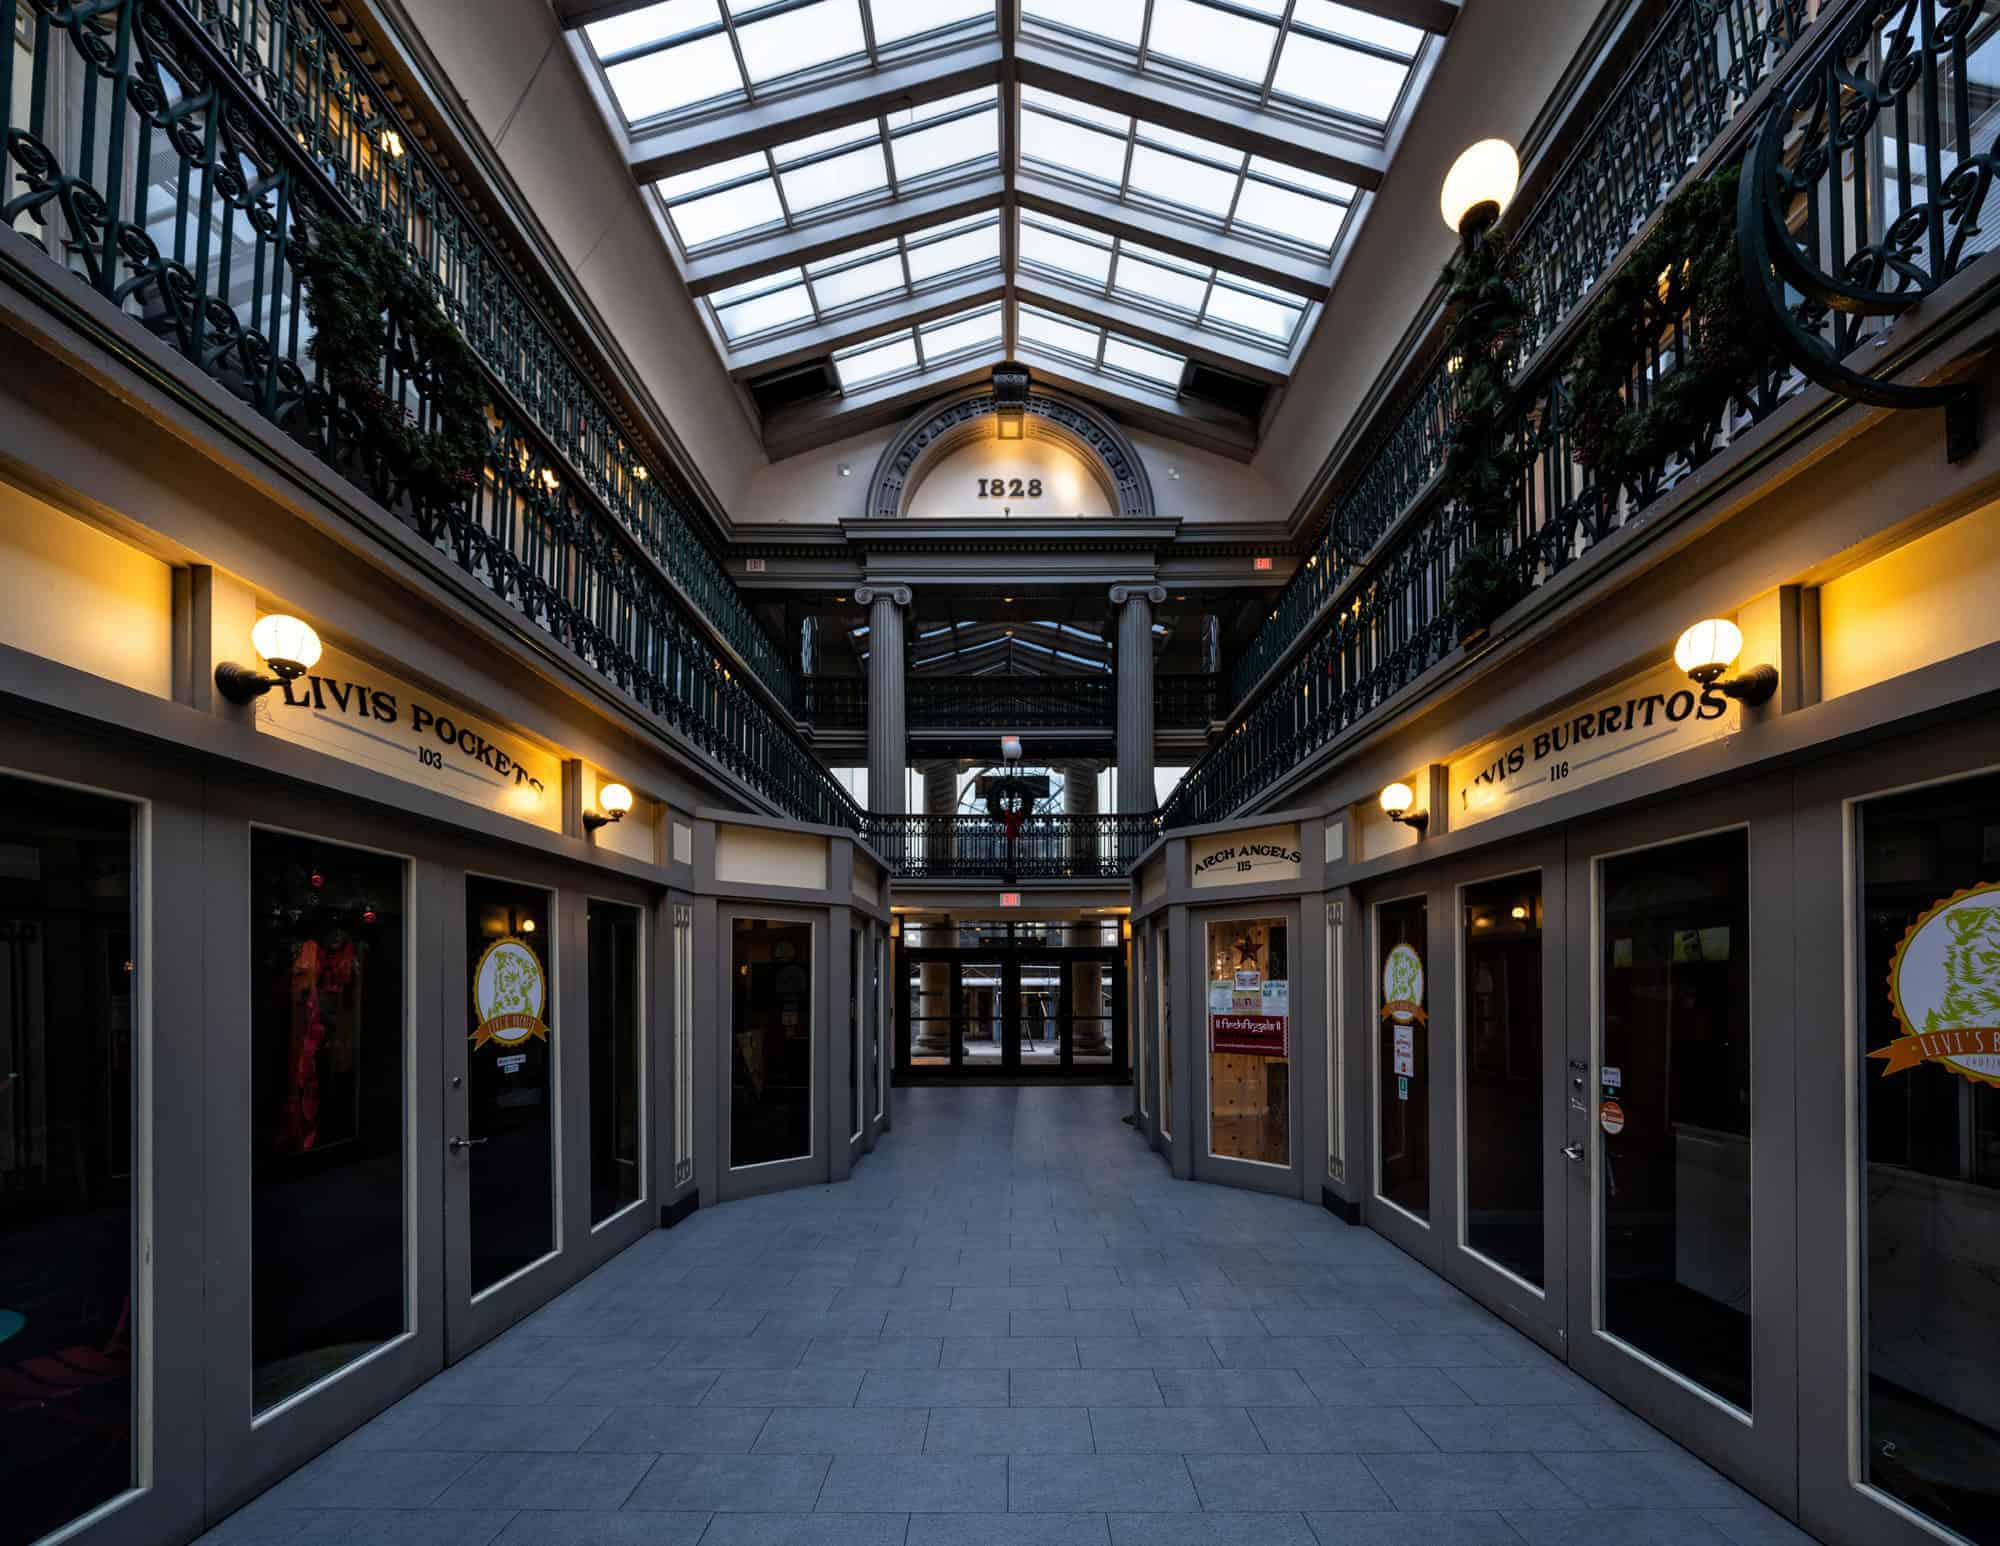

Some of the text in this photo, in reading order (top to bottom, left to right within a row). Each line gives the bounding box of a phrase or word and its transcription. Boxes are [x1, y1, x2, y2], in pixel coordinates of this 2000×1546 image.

[977, 478, 1042, 497] 1828
[283, 675, 397, 723] LIVI'S
[1533, 686, 1727, 761] BURRITOS
[418, 745, 443, 770] 103
[1550, 761, 1569, 782] 116
[1194, 844, 1302, 876] ARCH ANGELS
[1237, 860, 1252, 872] 115
[1919, 1030, 1985, 1057] LIVI'S
